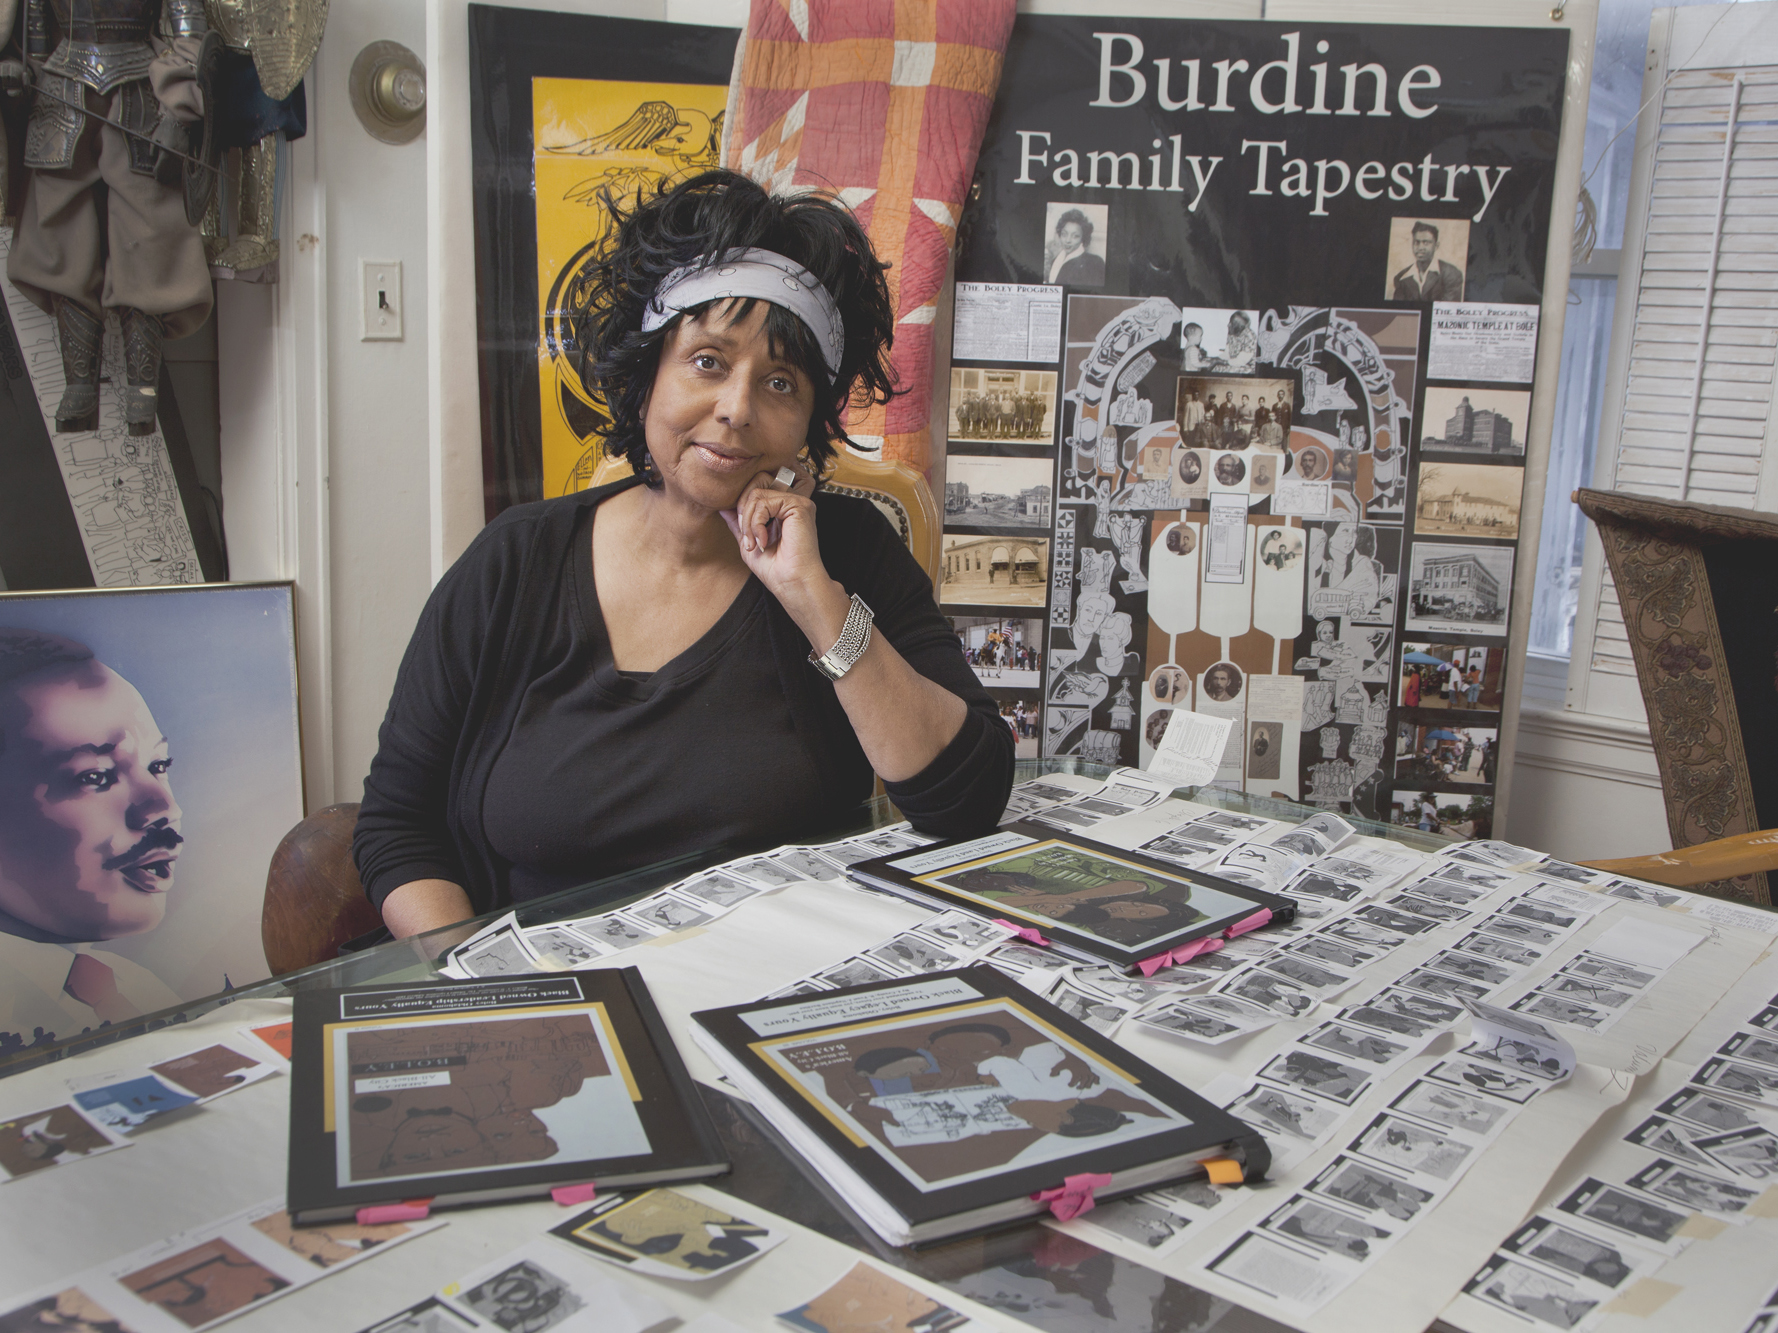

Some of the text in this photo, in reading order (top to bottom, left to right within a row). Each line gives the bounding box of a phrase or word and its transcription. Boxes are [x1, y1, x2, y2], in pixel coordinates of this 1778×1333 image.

[1090, 31, 1442, 119] Burdine
[1014, 130, 1512, 223] Family Tapestry
[1472, 321, 1503, 331] TEMPLE
[1503, 321, 1514, 331] AT
[176, 519, 189, 544] CRISIS
[436, 996, 496, 1004] Leadership
[763, 988, 963, 1026] Black Owned Legacy Equally Yours
